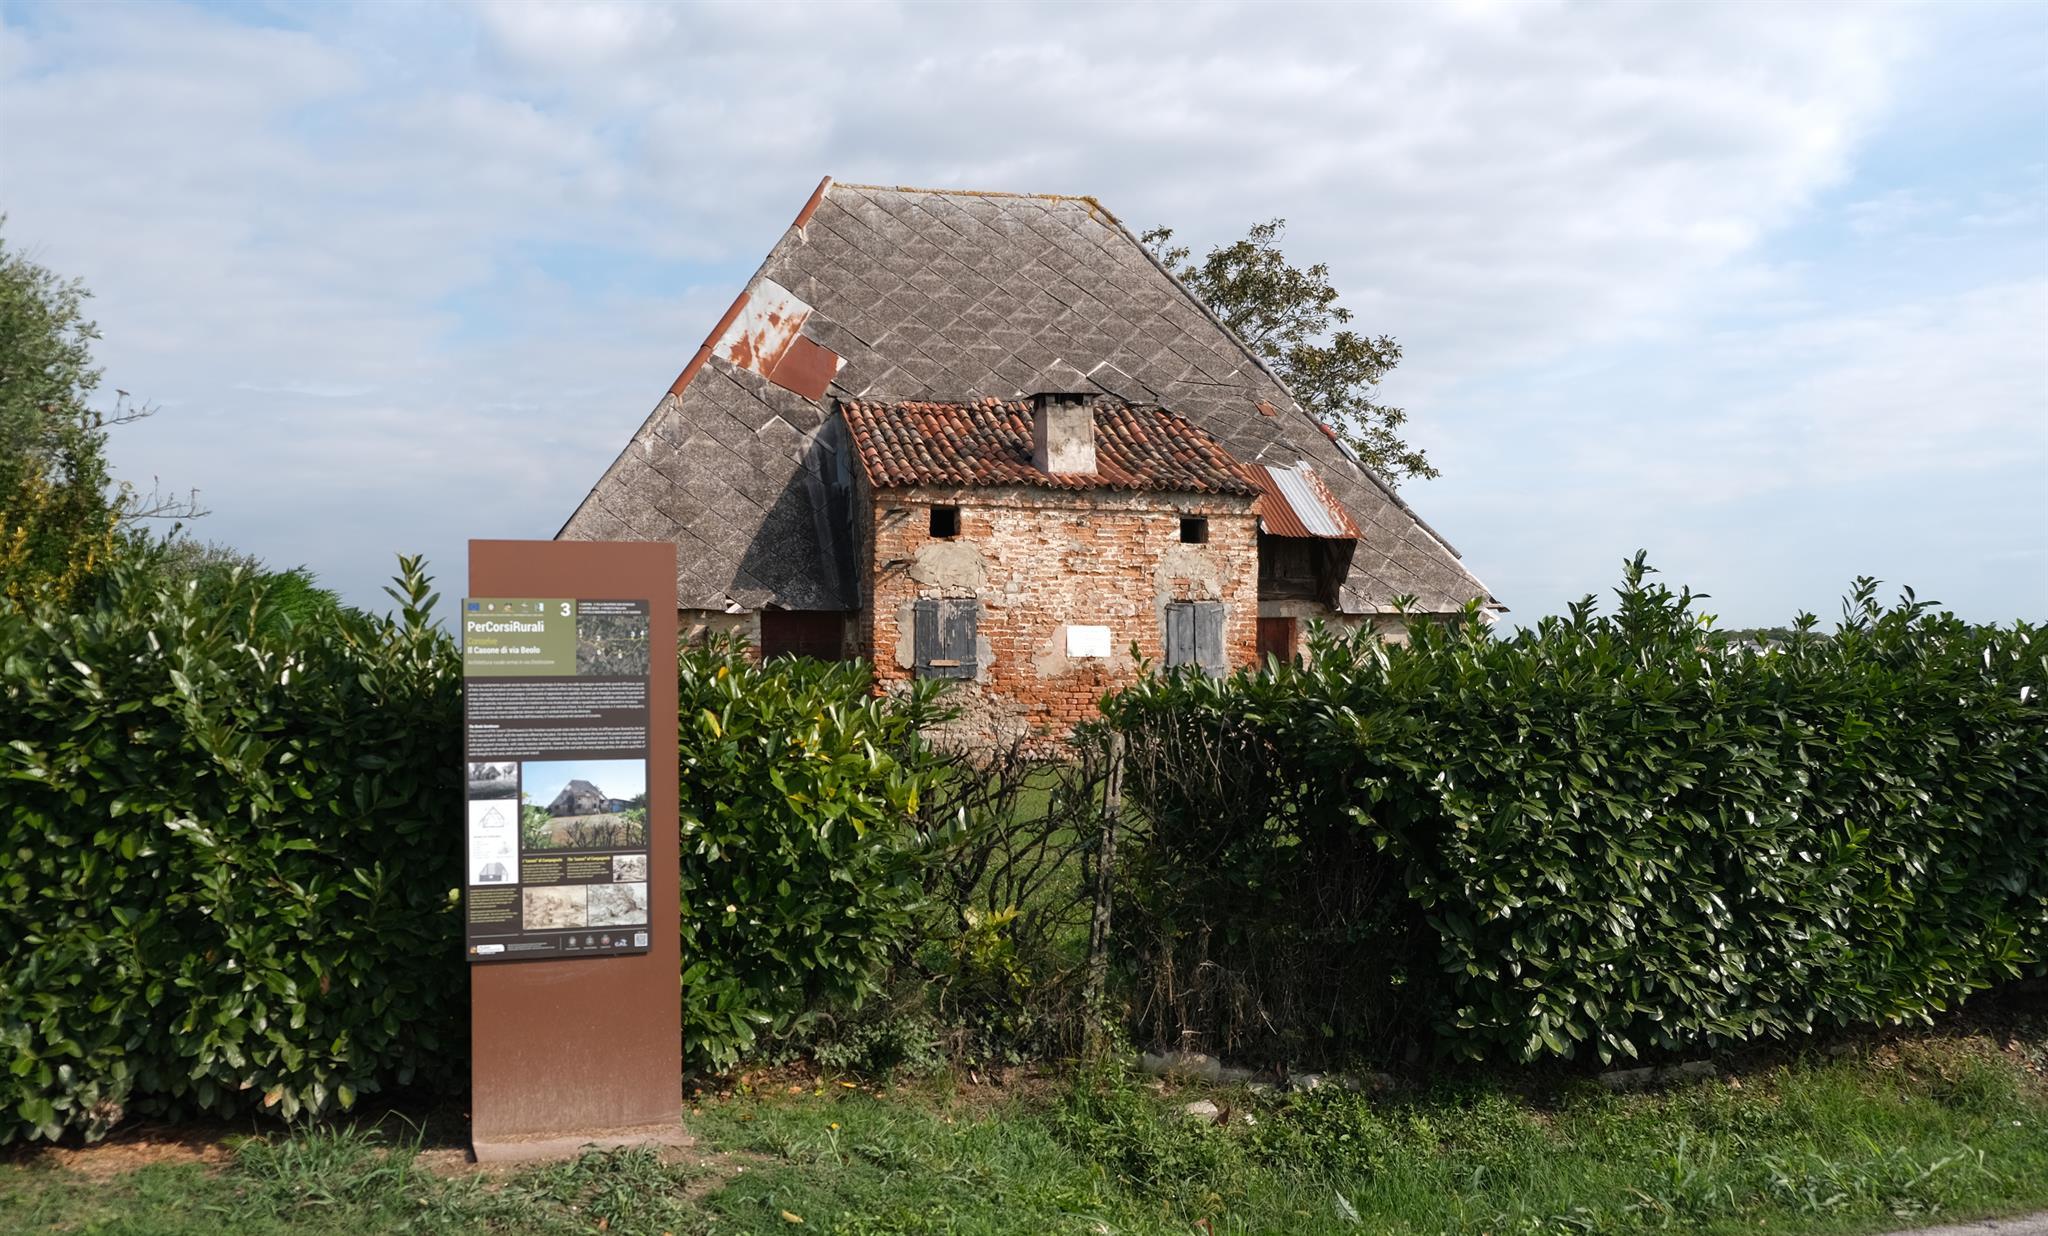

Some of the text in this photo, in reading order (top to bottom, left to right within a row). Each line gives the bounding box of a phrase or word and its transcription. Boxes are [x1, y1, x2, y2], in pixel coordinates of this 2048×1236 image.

[560, 602, 571, 617] 3
[467, 620, 544, 633] PerCorsiRurali
[467, 646, 540, 654] Il Casone di via Beolo
